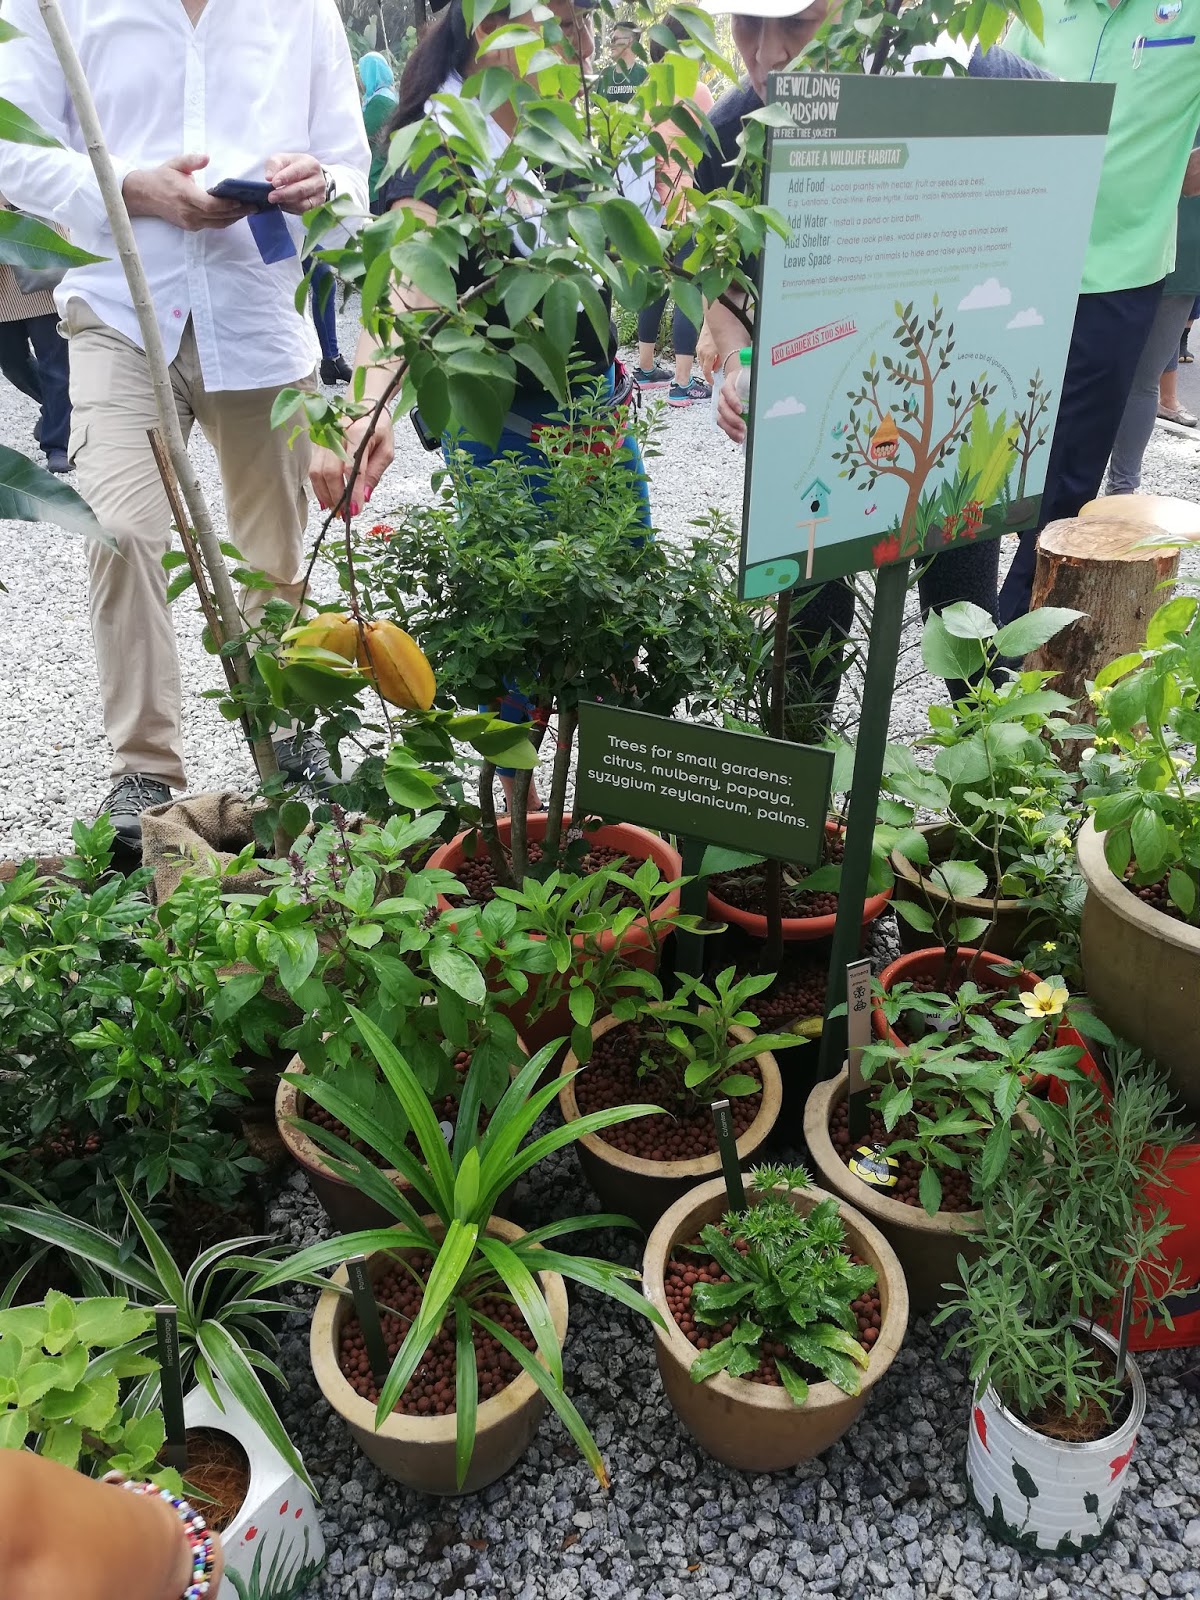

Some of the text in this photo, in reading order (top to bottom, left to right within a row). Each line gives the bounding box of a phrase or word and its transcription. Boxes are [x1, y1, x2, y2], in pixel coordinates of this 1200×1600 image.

[776, 76, 840, 100] REWILDING
[776, 101, 839, 124] OADSHOW
[781, 128, 795, 138] FREE
[797, 128, 811, 138] TREE
[812, 128, 837, 139] SOCIETY
[789, 149, 901, 167] CREATE A WILDLIFE HABITAT
[788, 177, 804, 193] Add
[806, 177, 825, 192] Food
[831, 183, 851, 191] Local
[853, 182, 874, 192] plants
[876, 181, 890, 190] with
[916, 179, 928, 190] fruit
[938, 178, 957, 187] seeds
[787, 214, 802, 229] Add
[804, 214, 828, 228] Water
[833, 218, 855, 227] Install
[863, 217, 881, 226] pond
[891, 214, 904, 223] bird
[785, 234, 800, 249] Add
[802, 233, 830, 248] Shelter
[837, 236, 860, 245] Create
[862, 234, 876, 243] rock
[898, 232, 915, 241] wood
[916, 232, 931, 241] piles
[941, 229, 957, 239] hang
[959, 228, 967, 237] up
[784, 254, 806, 269] Leave
[808, 252, 831, 269] Space
[837, 255, 863, 265] Privacy
[864, 253, 873, 262] for
[875, 250, 901, 260] animals
[902, 250, 909, 258] to
[910, 249, 925, 257] hide
[926, 247, 939, 257] and
[940, 246, 955, 255] raise
[957, 245, 976, 256] young
[782, 276, 828, 288] Environmental
[829, 273, 866, 283] Stewardship
[785, 338, 812, 356] GARDEN
[812, 333, 820, 345] IS
[820, 329, 834, 342] TOO
[834, 319, 857, 336] SMALL
[607, 735, 793, 786] Trees for small gardens:
[603, 754, 794, 807] citrus, mulberry, papaya,
[588, 769, 809, 829] syzygium zeylanicum, palms.
[720, 1111, 729, 1137] Culantro
[355, 1266, 365, 1290] Pandan
[164, 1318, 172, 1344] Borage
